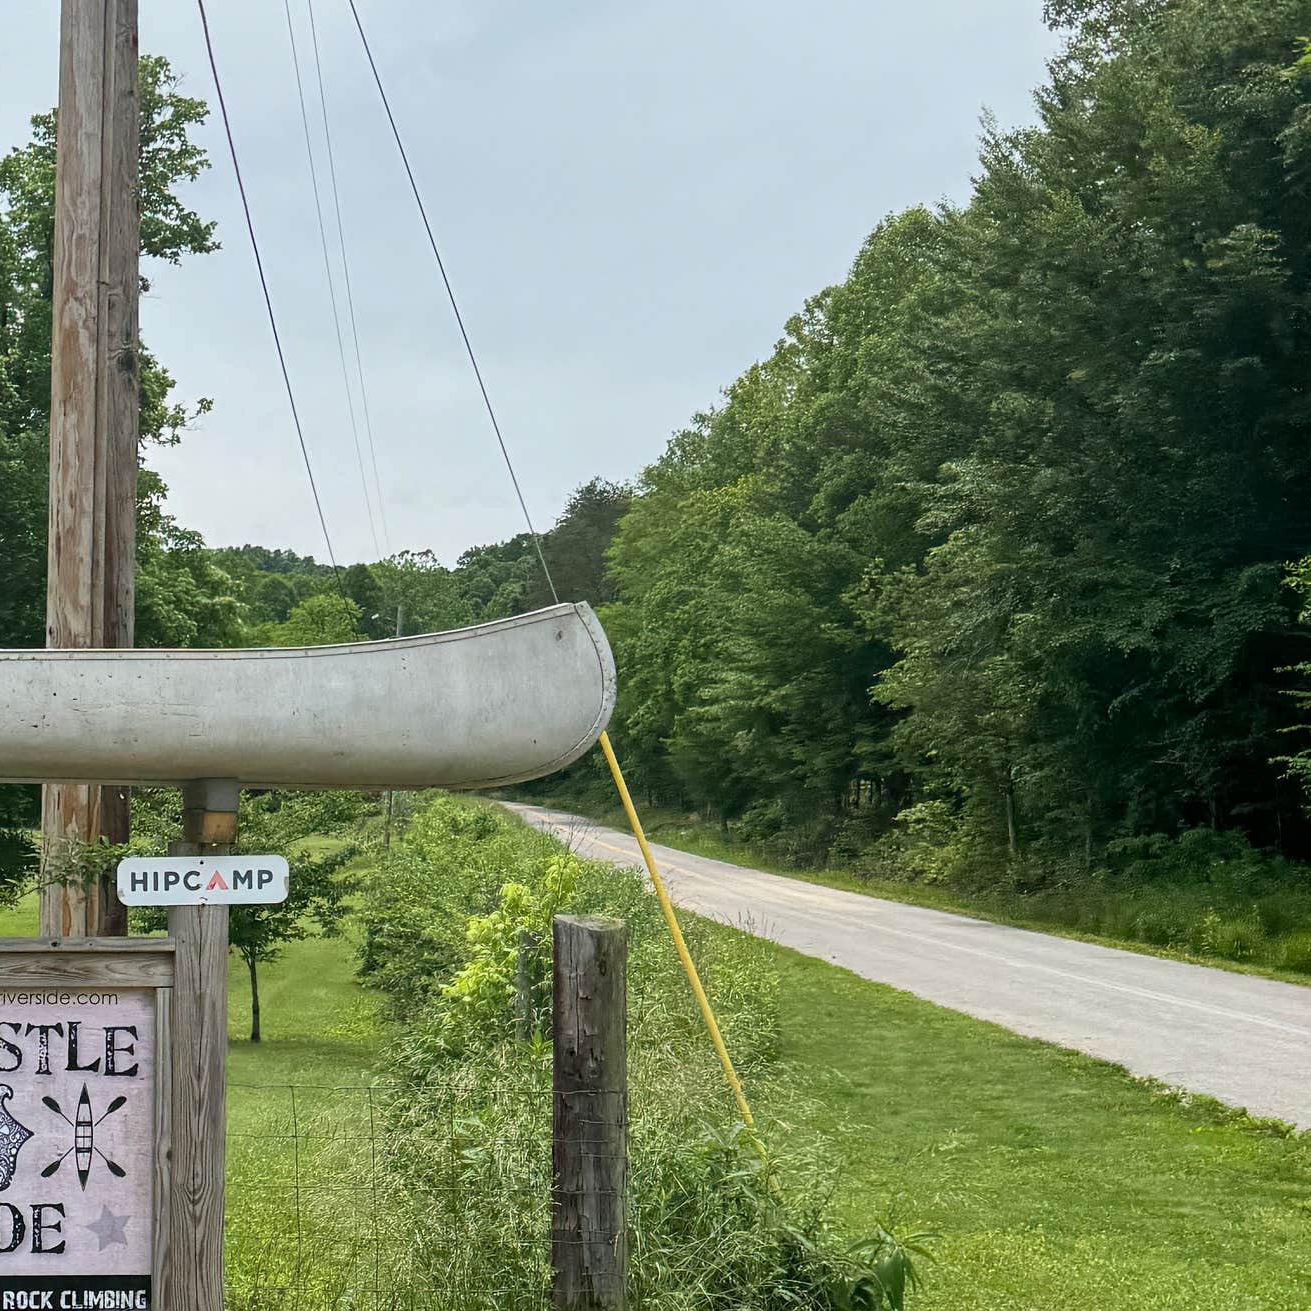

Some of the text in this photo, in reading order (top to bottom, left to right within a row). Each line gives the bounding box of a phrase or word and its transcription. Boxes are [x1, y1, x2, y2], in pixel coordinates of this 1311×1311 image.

[130, 869, 274, 892] HIPCAMP
[2, 1289, 53, 1311] ROCK
[59, 1289, 147, 1310] CLIMBING
